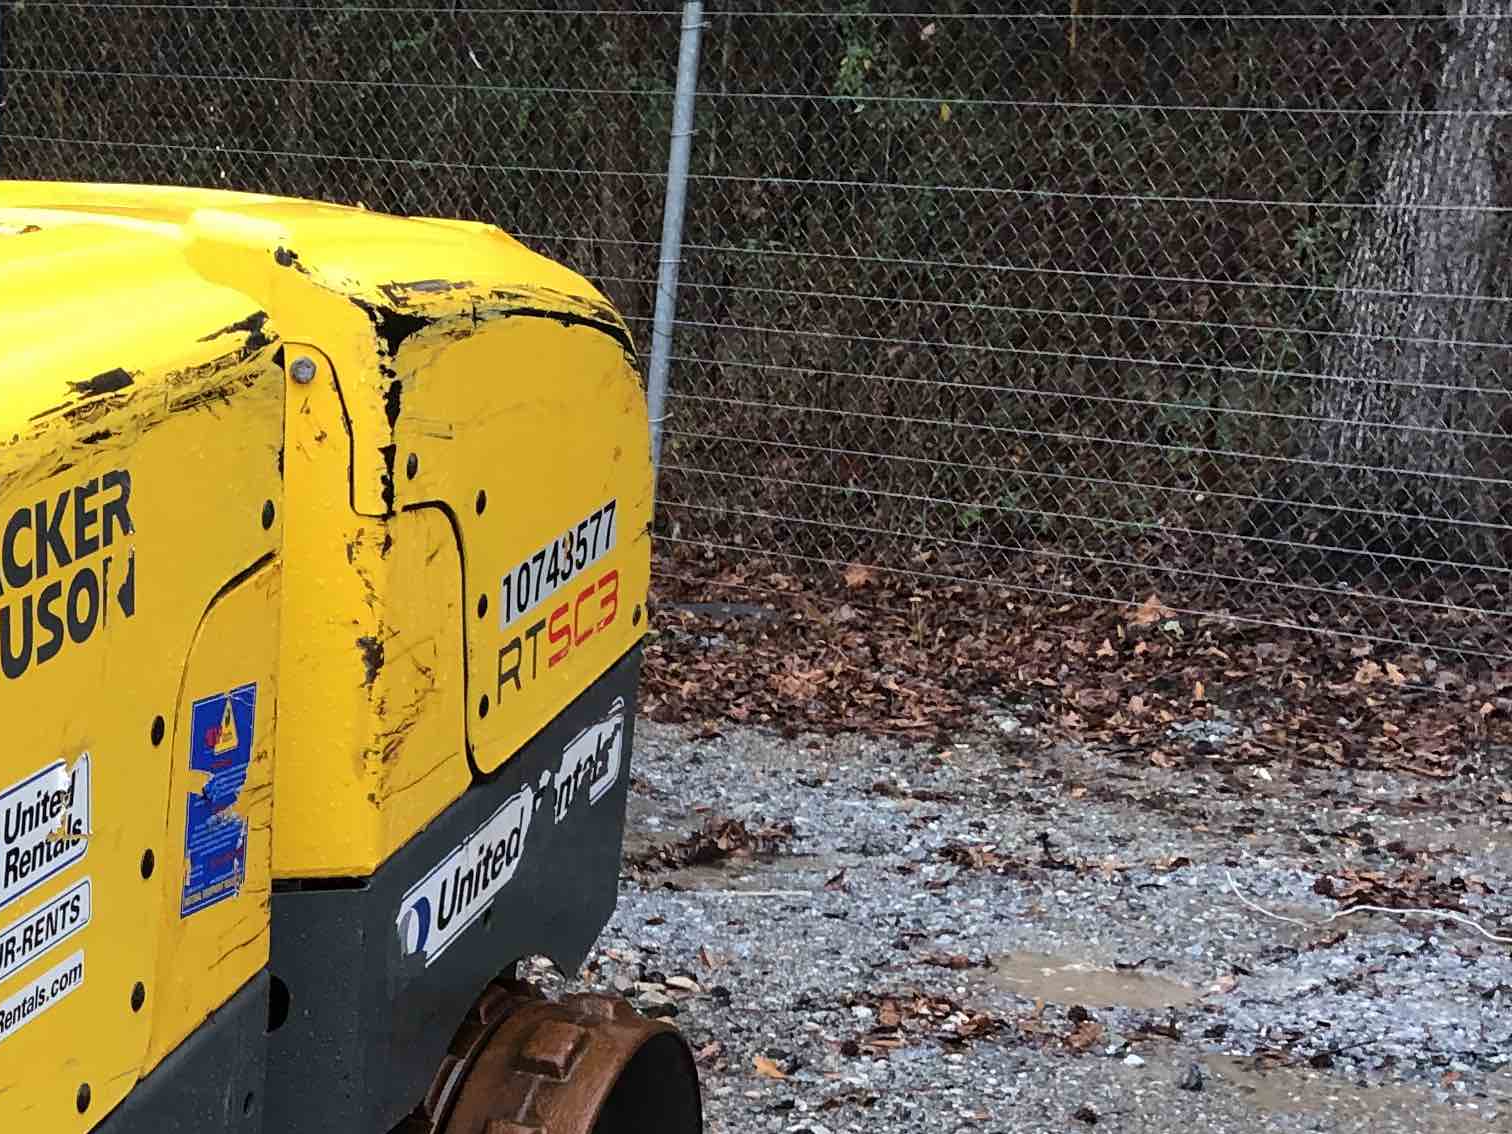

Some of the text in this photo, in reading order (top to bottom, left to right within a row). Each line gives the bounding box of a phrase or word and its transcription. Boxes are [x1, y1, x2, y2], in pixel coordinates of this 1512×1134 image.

[502, 498, 617, 623] 10743577
[3, 769, 76, 845] United
[3, 813, 83, 889] Rentals
[437, 806, 525, 931] United
